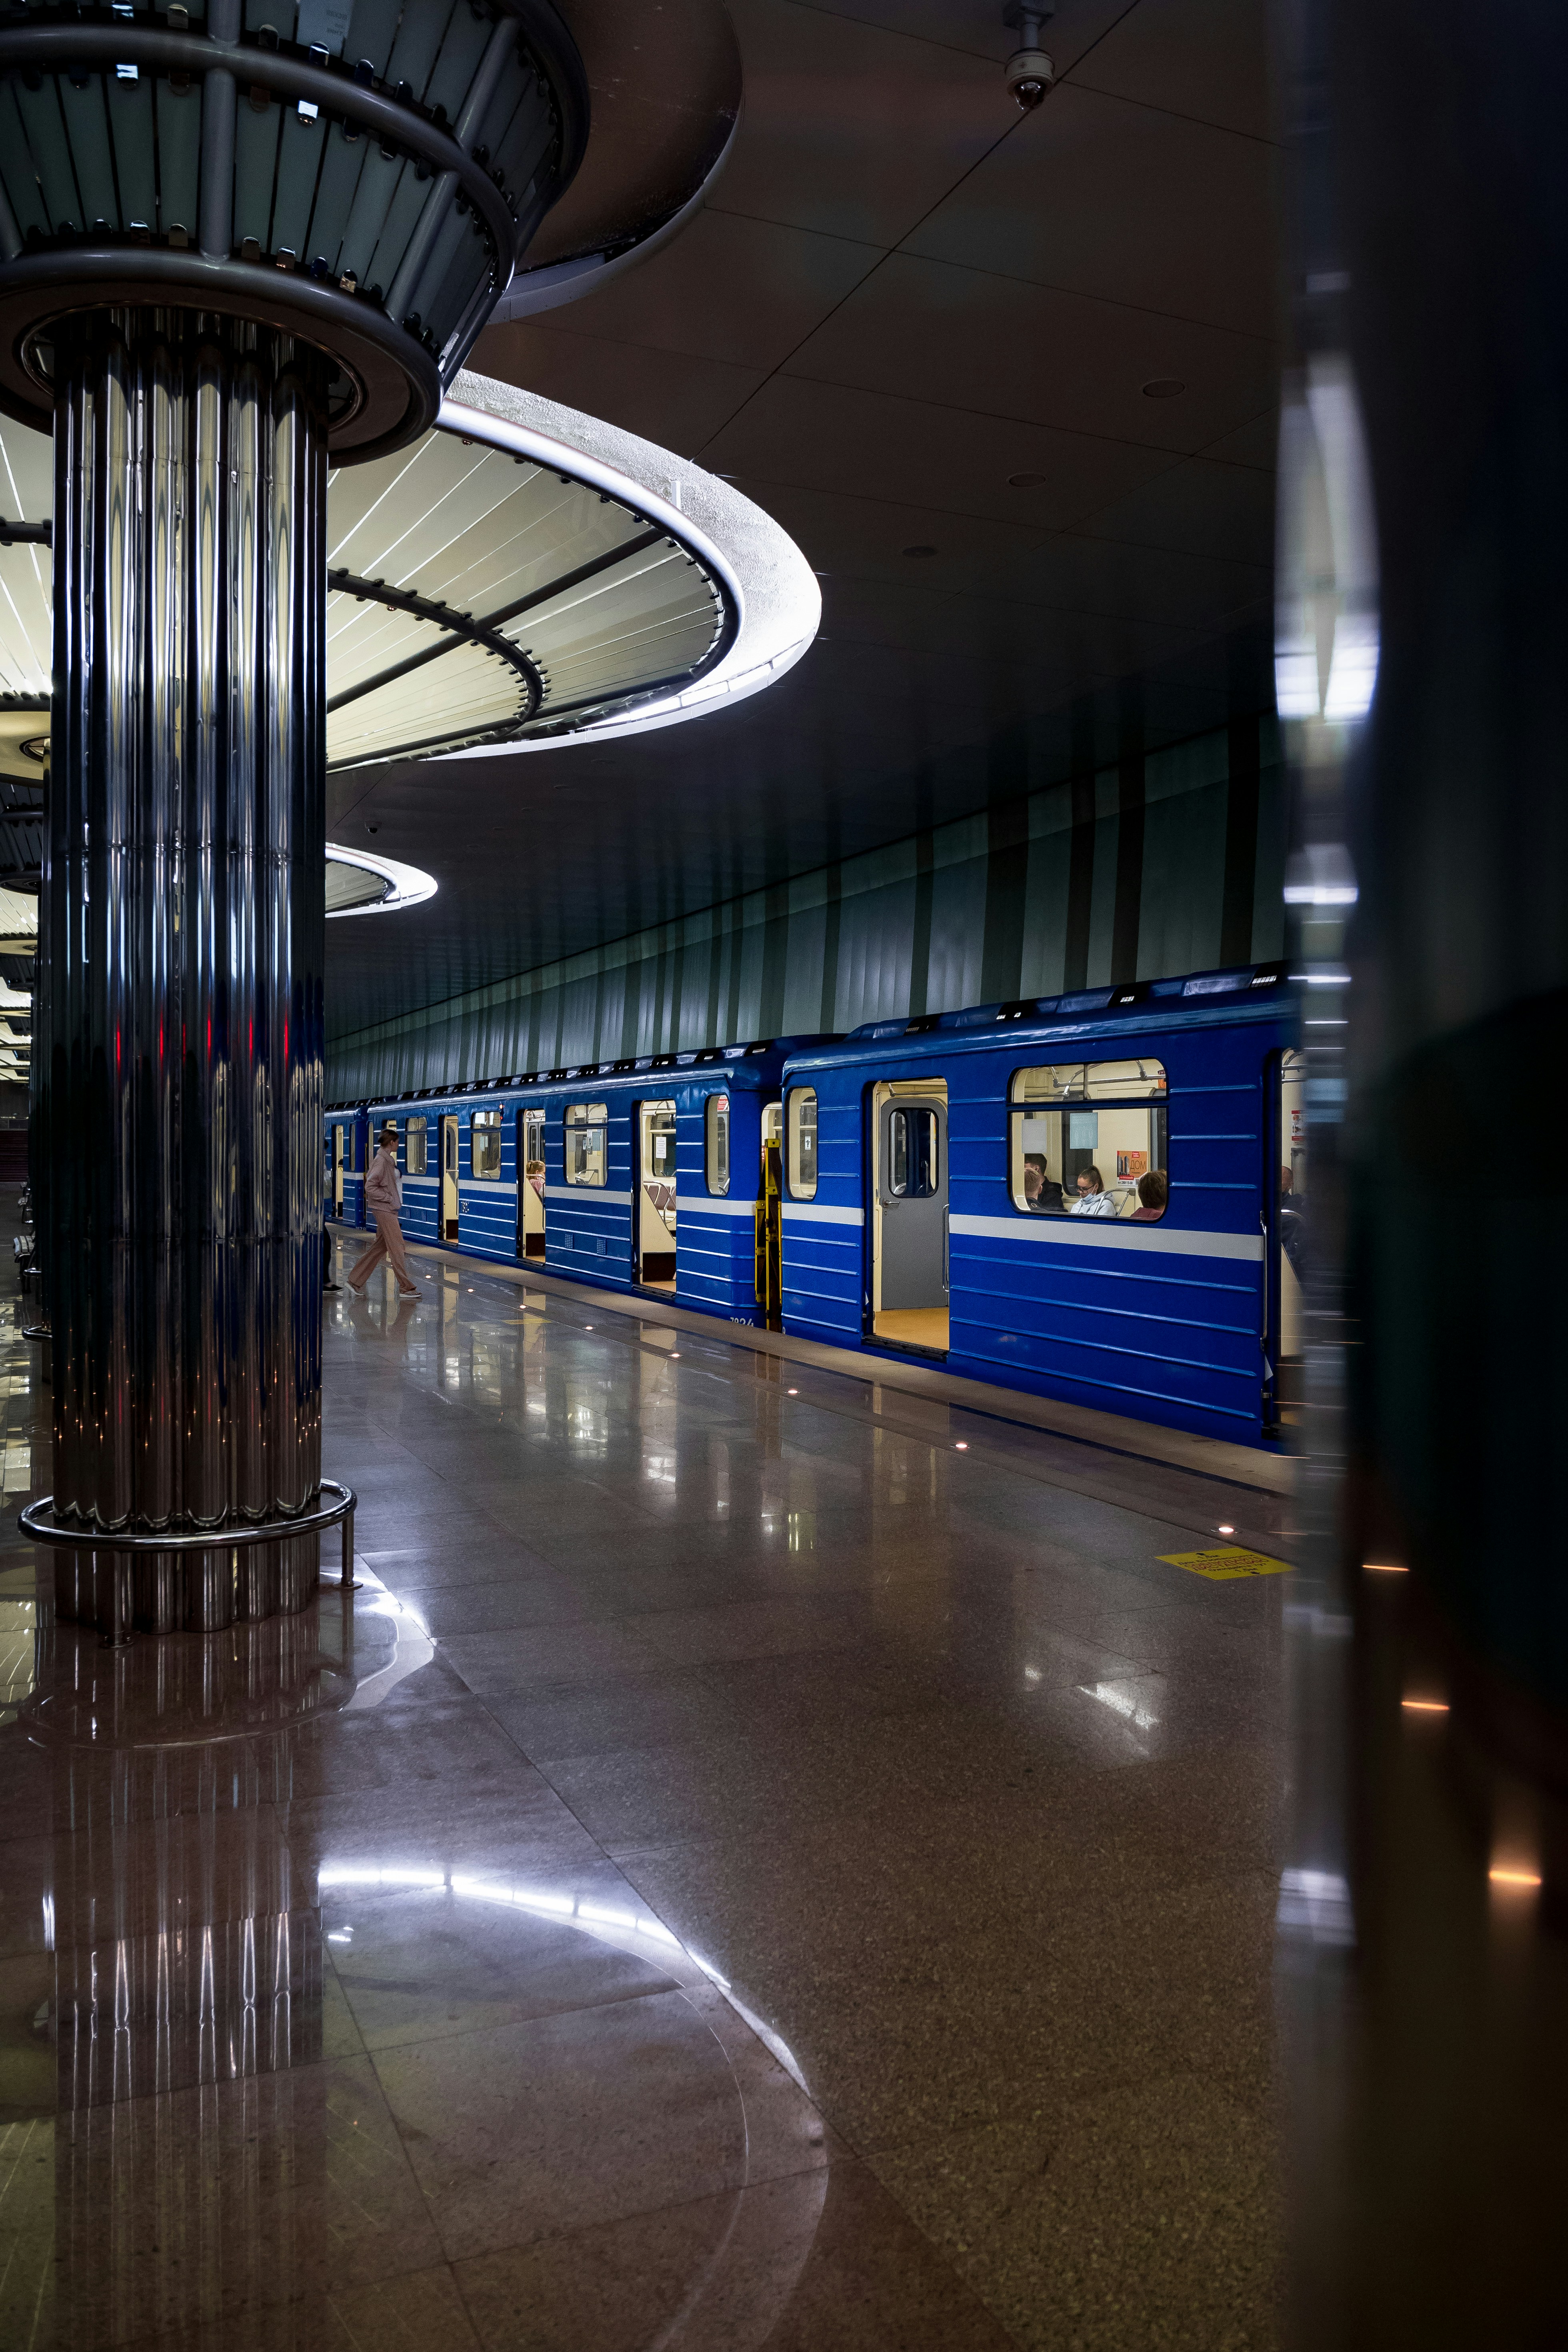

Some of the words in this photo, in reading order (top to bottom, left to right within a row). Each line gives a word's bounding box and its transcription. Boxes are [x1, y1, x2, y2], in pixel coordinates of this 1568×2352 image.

[1130, 1160, 1146, 1171] ДОМ
[1183, 1556, 1262, 1568] СОБЛЮДАЙТЕ
[1190, 1558, 1270, 1570] ДИСТАНЦИЮ
